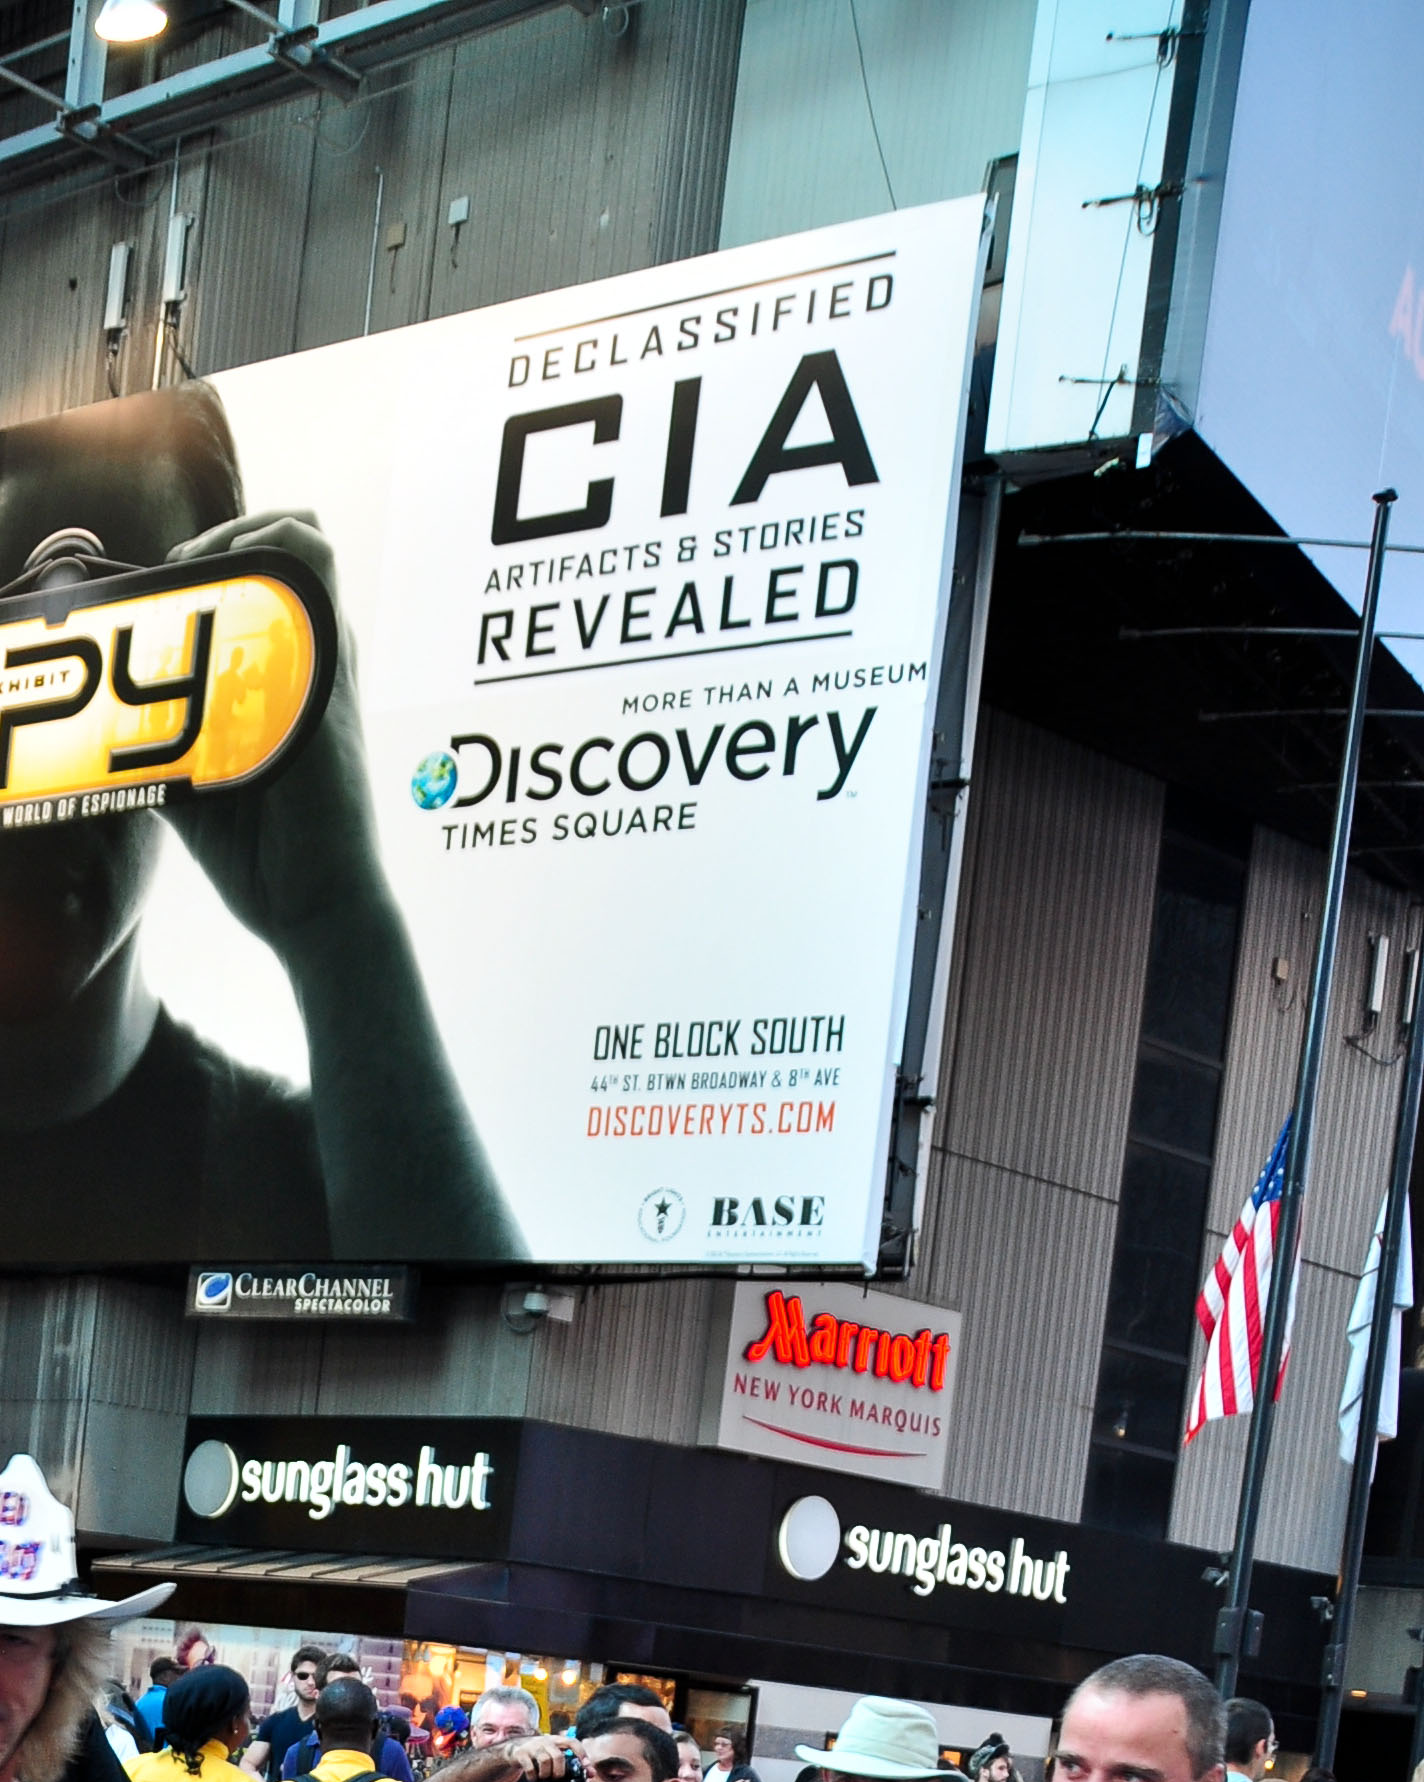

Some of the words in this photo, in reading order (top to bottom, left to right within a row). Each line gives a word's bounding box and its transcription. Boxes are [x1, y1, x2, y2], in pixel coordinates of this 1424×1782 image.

[507, 273, 895, 389] DECLASSIFIED
[490, 347, 881, 547] CIA
[483, 541, 662, 595] ARTIFACTS
[676, 535, 697, 563] &
[713, 508, 865, 558] STORIES
[476, 557, 860, 665] REVEALED
[620, 689, 694, 716] MORE
[703, 679, 773, 707] THAN
[783, 677, 800, 698] A
[811, 661, 929, 694] MUSEUM
[2, 800, 52, 828] WORLD
[56, 796, 75, 820] OF
[80, 782, 167, 817] ESPIONAGE
[441, 816, 538, 852] TIMES
[552, 801, 699, 842] SQUARE
[593, 1023, 645, 1061] ONE
[653, 1019, 742, 1059] BLOCK
[750, 1014, 846, 1056] SOUTH
[622, 1073, 642, 1092] ST.
[646, 1072, 686, 1091] BTWN
[691, 1069, 768, 1090] BROADWAY
[770, 1069, 782, 1088] &
[813, 1067, 841, 1086] AVE
[586, 1101, 836, 1137] DISCOVERYTS.COM
[709, 1195, 826, 1227] BASE
[294, 1298, 391, 1313] SPECTACOLOR
[744, 1289, 951, 1392] Marriott
[733, 1372, 781, 1401] NEW
[788, 1384, 842, 1416] YORK
[849, 1398, 942, 1437] MARQUIS
[241, 1444, 413, 1521] sunglass
[415, 1445, 494, 1511] hut
[844, 1523, 1006, 1597] sunglass
[1006, 1537, 1071, 1604] hut
